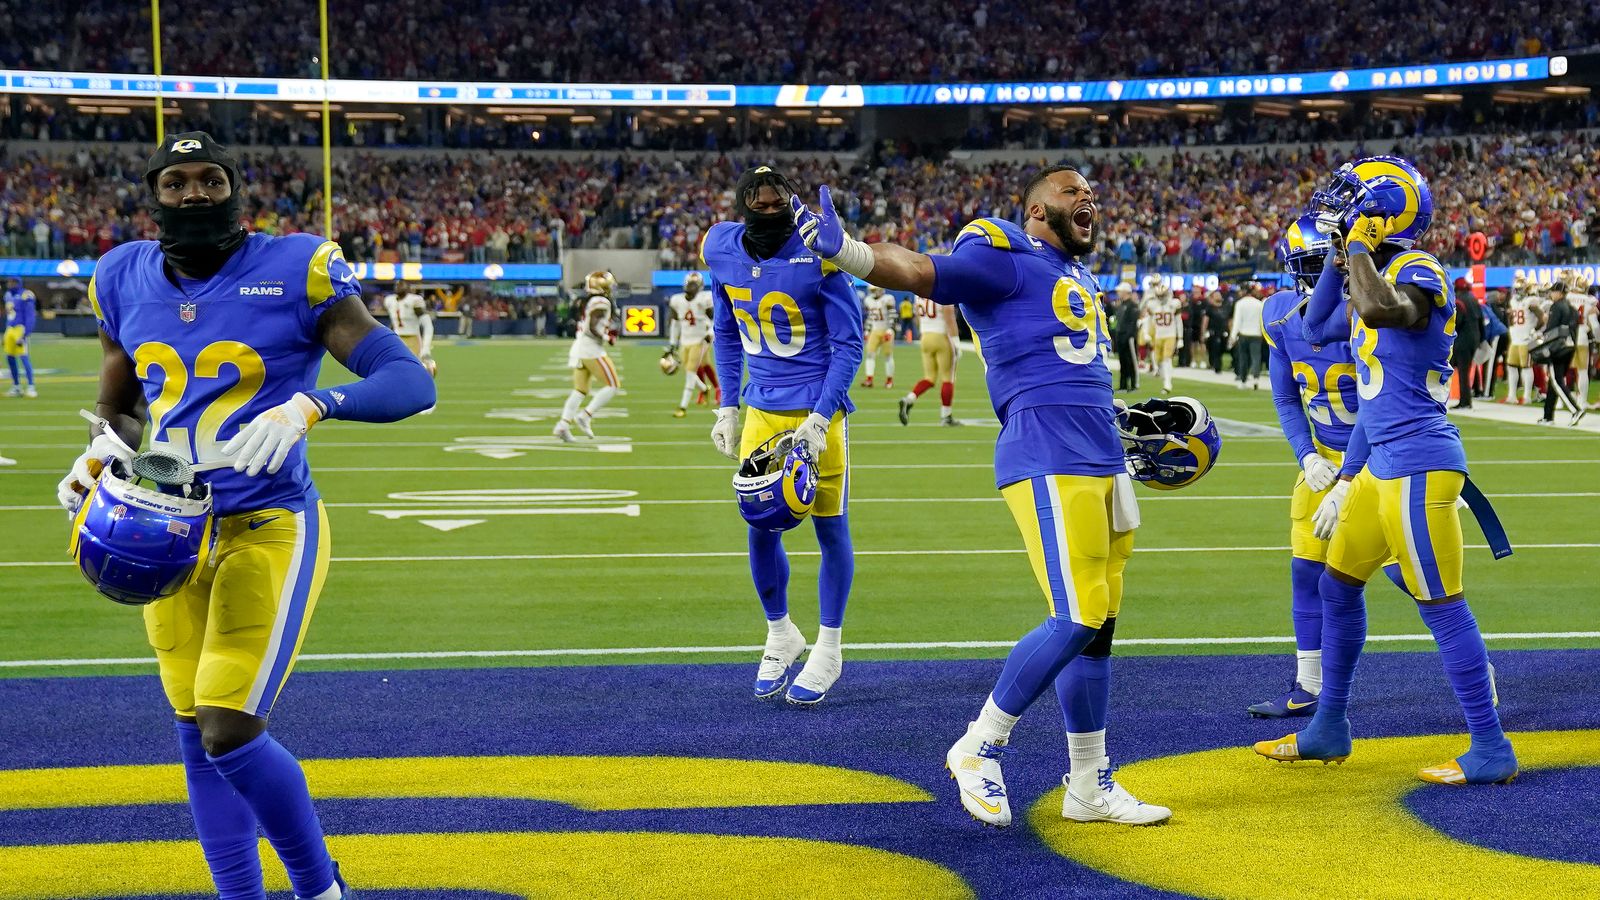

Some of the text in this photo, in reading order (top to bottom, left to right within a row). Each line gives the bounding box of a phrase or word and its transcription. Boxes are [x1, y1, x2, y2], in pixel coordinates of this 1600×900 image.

[1371, 68, 1438, 86] RAMS
[1447, 62, 1529, 81] HOUSE
[775, 84, 865, 107] LA
[934, 85, 1082, 102] OUR HOUSE
[1146, 77, 1303, 97] YOUR HOUSE
[347, 262, 423, 280] USE
[240, 286, 284, 296] RAMS
[723, 284, 807, 358] 50
[1154, 311, 1173, 327] 20
[1351, 315, 1385, 401] 3
[133, 339, 267, 465] 22
[1291, 360, 1358, 426] 20
[122, 493, 182, 514] LOS ANGELES
